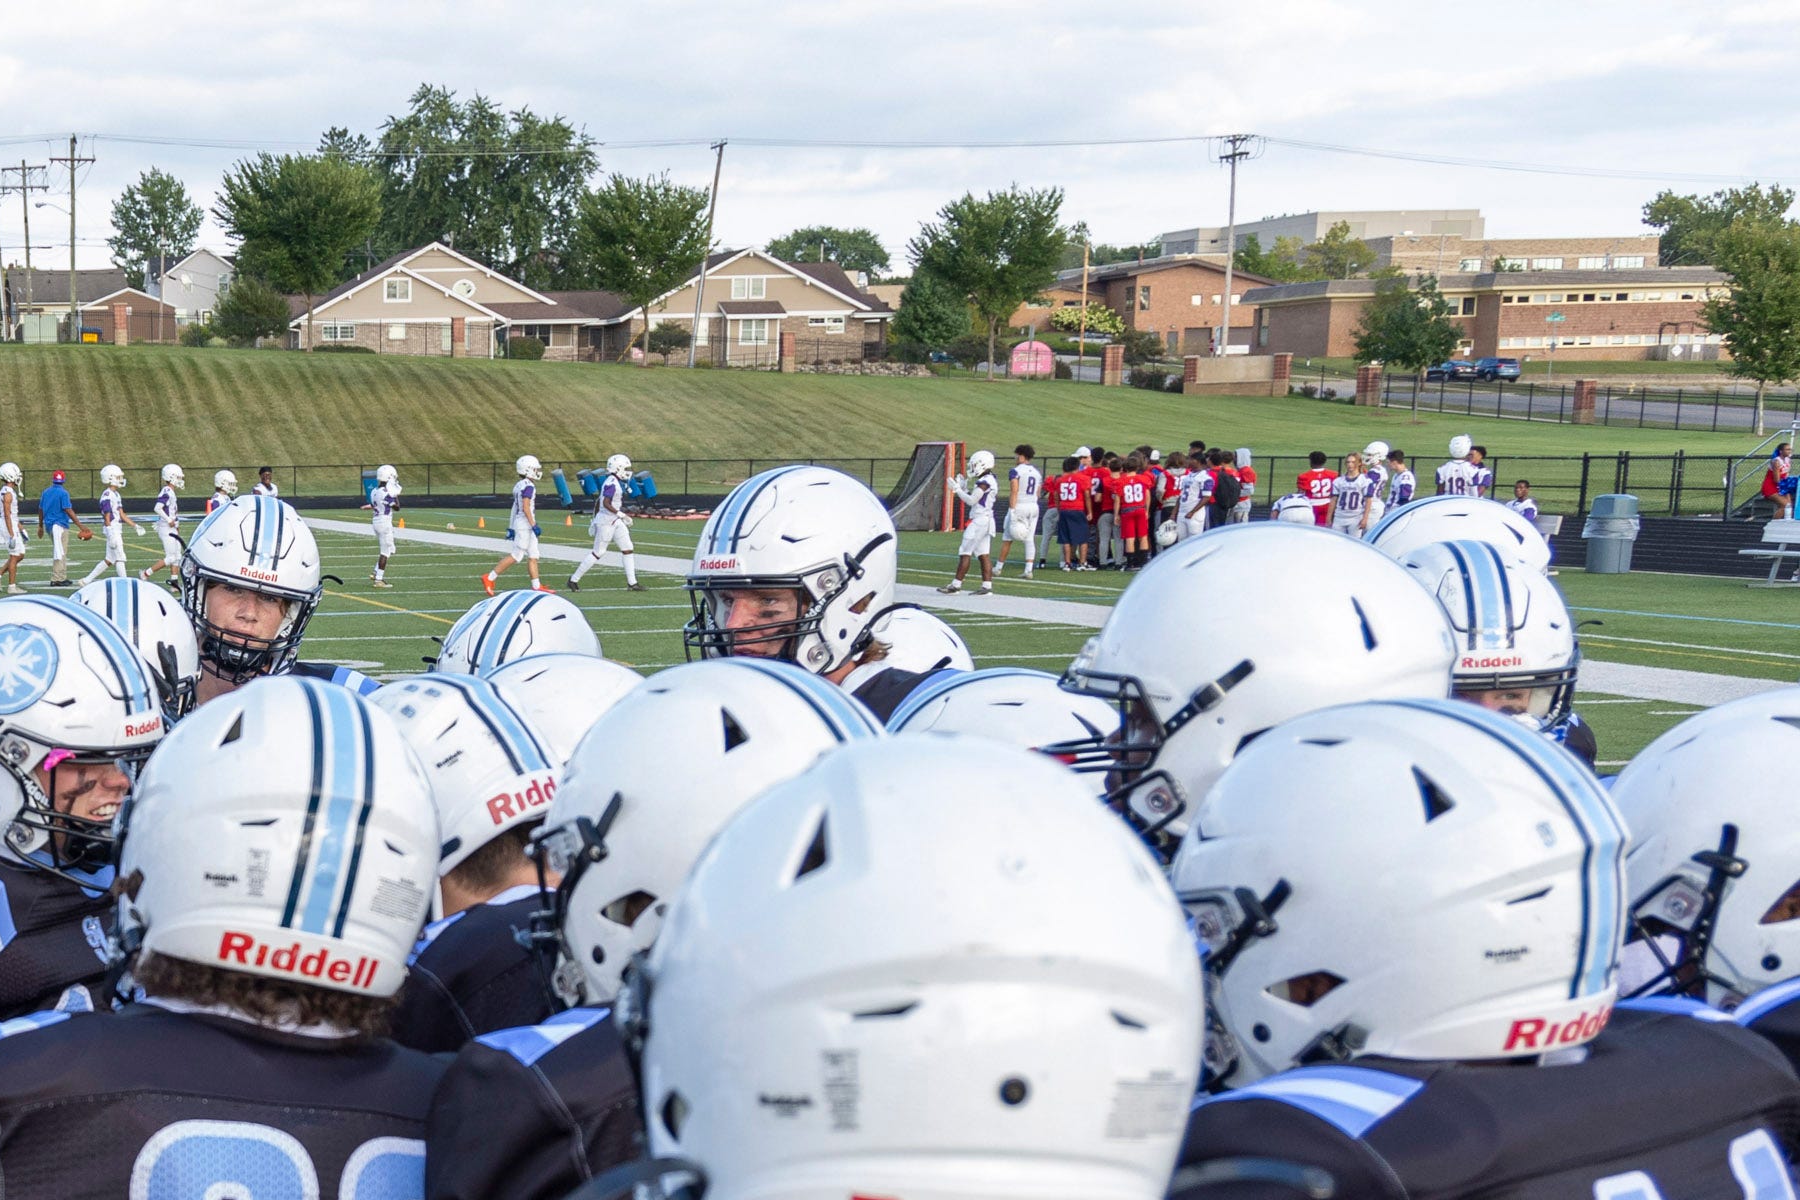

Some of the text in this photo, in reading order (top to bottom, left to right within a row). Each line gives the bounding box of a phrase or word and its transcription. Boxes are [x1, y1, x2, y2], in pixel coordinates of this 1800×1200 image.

[1026, 476, 1036, 495] 8
[1059, 482, 1078, 501] 53
[1090, 478, 1100, 496] 2
[1123, 484, 1144, 504] 88
[1310, 478, 1332, 498] 22
[1447, 477, 1466, 495] 18
[1338, 491, 1360, 511] 40
[699, 558, 737, 571] Riddell
[239, 566, 279, 583] Riddell
[1461, 656, 1522, 669] Riddell
[125, 717, 161, 738] Riddell
[486, 776, 557, 826] Ridd
[217, 931, 380, 990] Riddell
